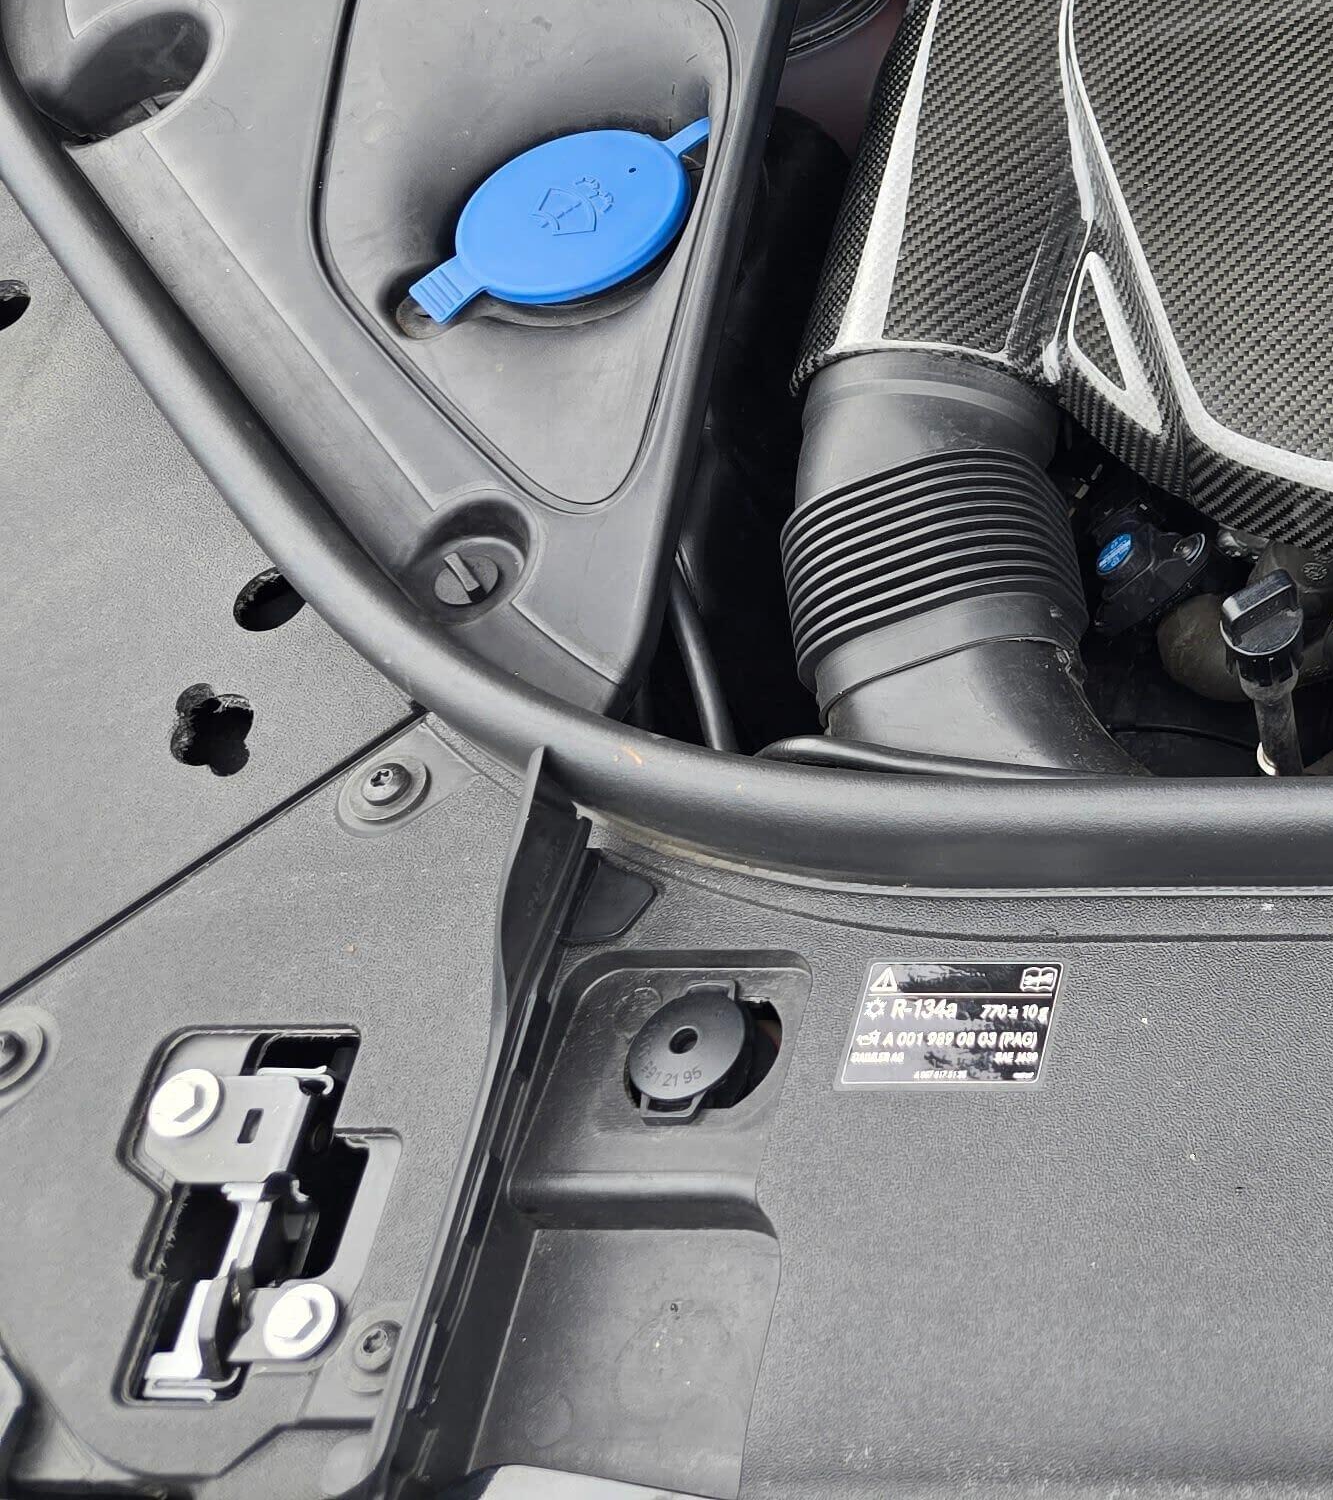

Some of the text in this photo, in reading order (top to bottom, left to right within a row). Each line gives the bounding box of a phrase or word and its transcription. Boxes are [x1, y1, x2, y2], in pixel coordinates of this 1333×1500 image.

[891, 998, 957, 1019] R-134a
[981, 1004, 1007, 1019] 770
[1021, 1003, 1037, 1018] 10
[882, 1032, 894, 1046] A
[896, 1032, 923, 1046] 001
[926, 1032, 953, 1047] 989
[998, 1032, 1038, 1049] (PAG)
